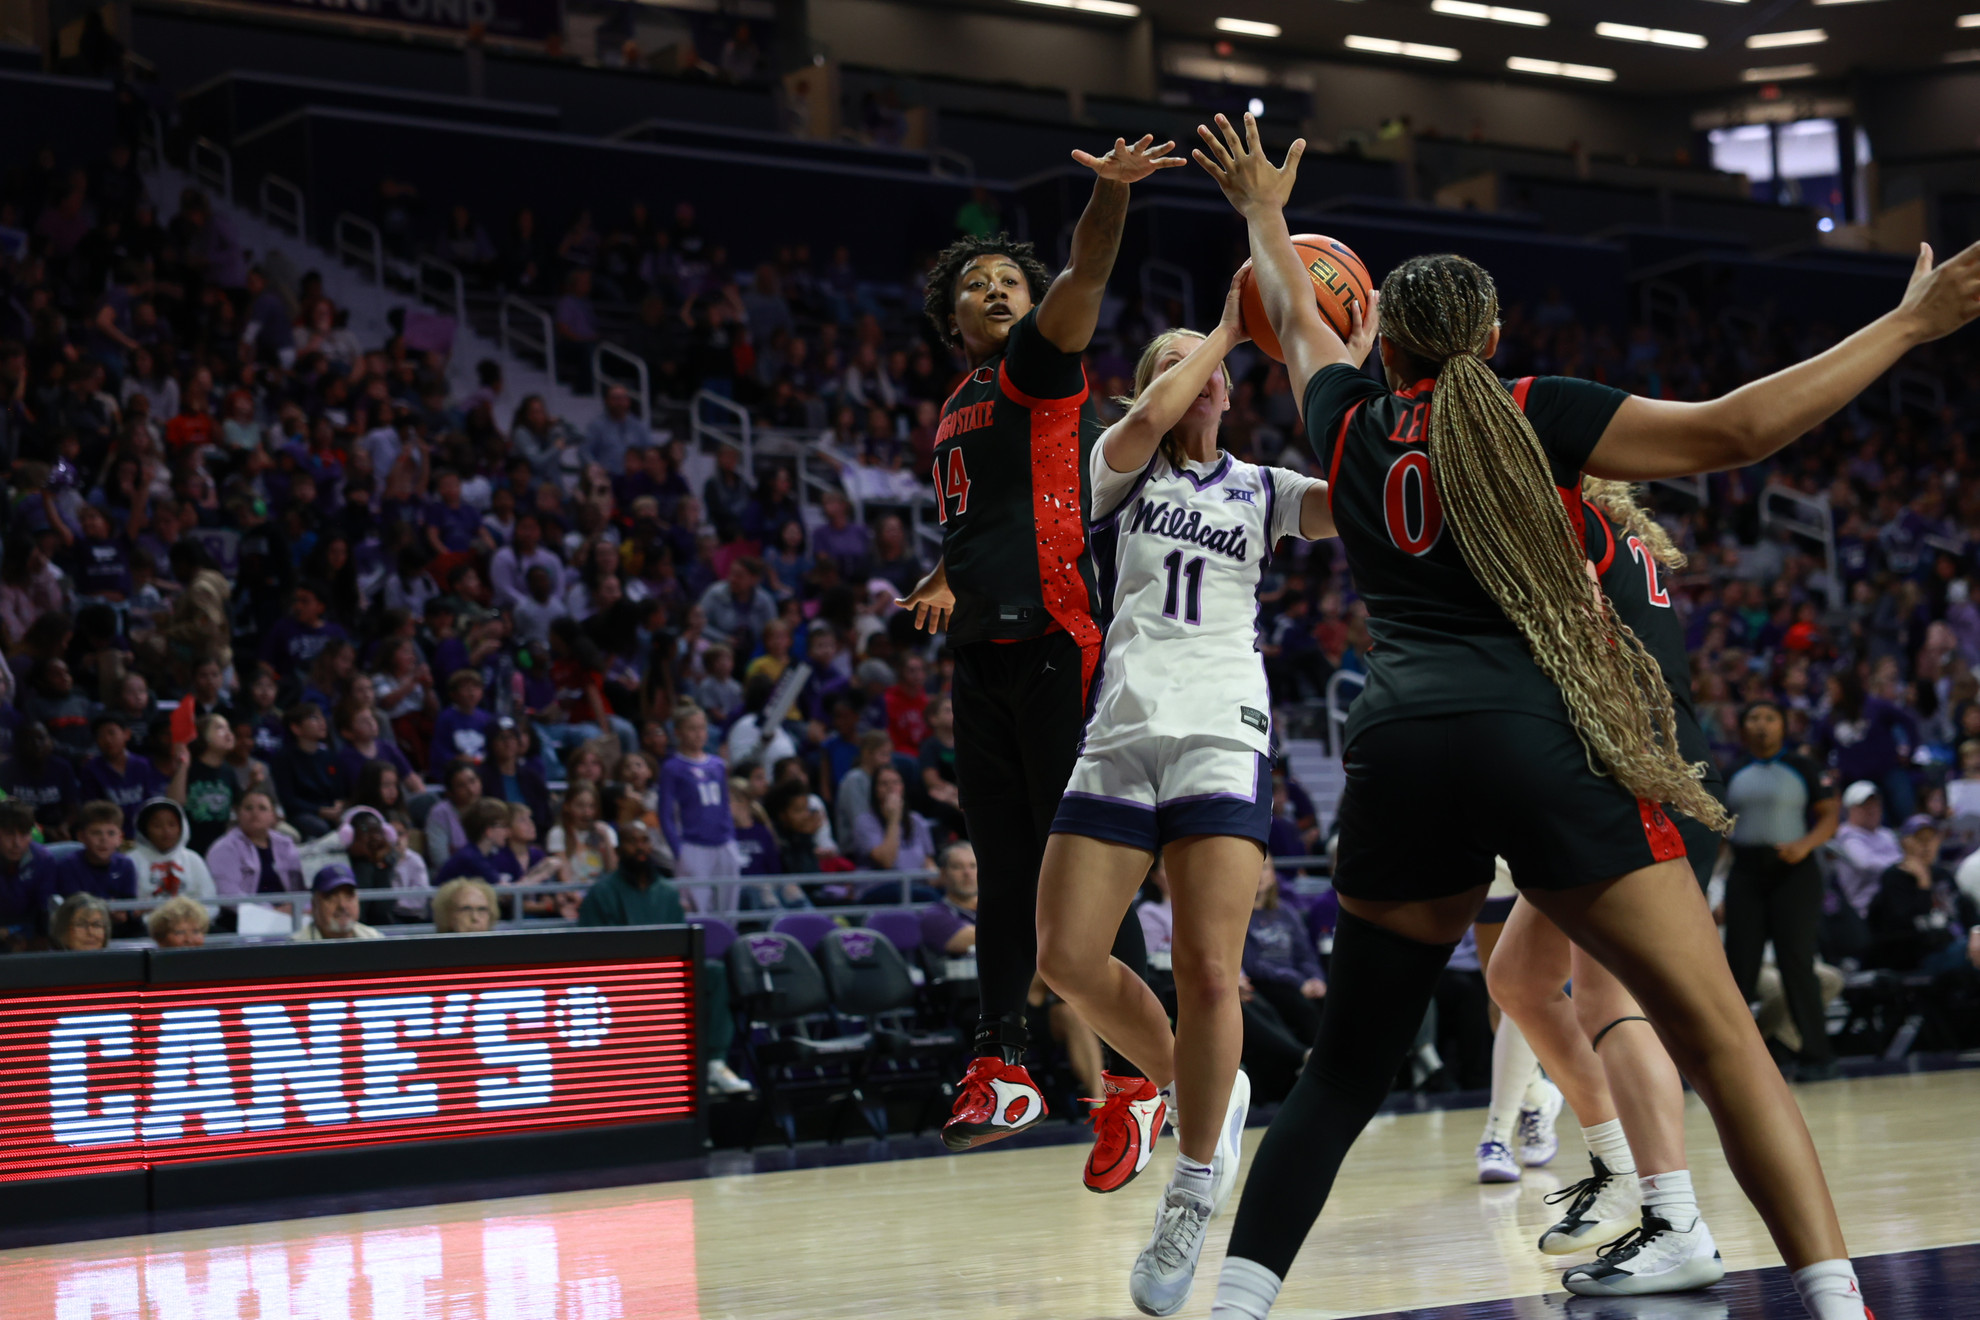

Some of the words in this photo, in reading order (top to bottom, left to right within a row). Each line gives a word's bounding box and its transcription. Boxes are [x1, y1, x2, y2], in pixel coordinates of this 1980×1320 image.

[953, 400, 996, 435] STATE
[932, 446, 971, 526] 14
[1383, 450, 1445, 557] 0
[1130, 497, 1247, 562] Wildcats
[1162, 549, 1206, 626] 11
[1627, 536, 1671, 608] 2
